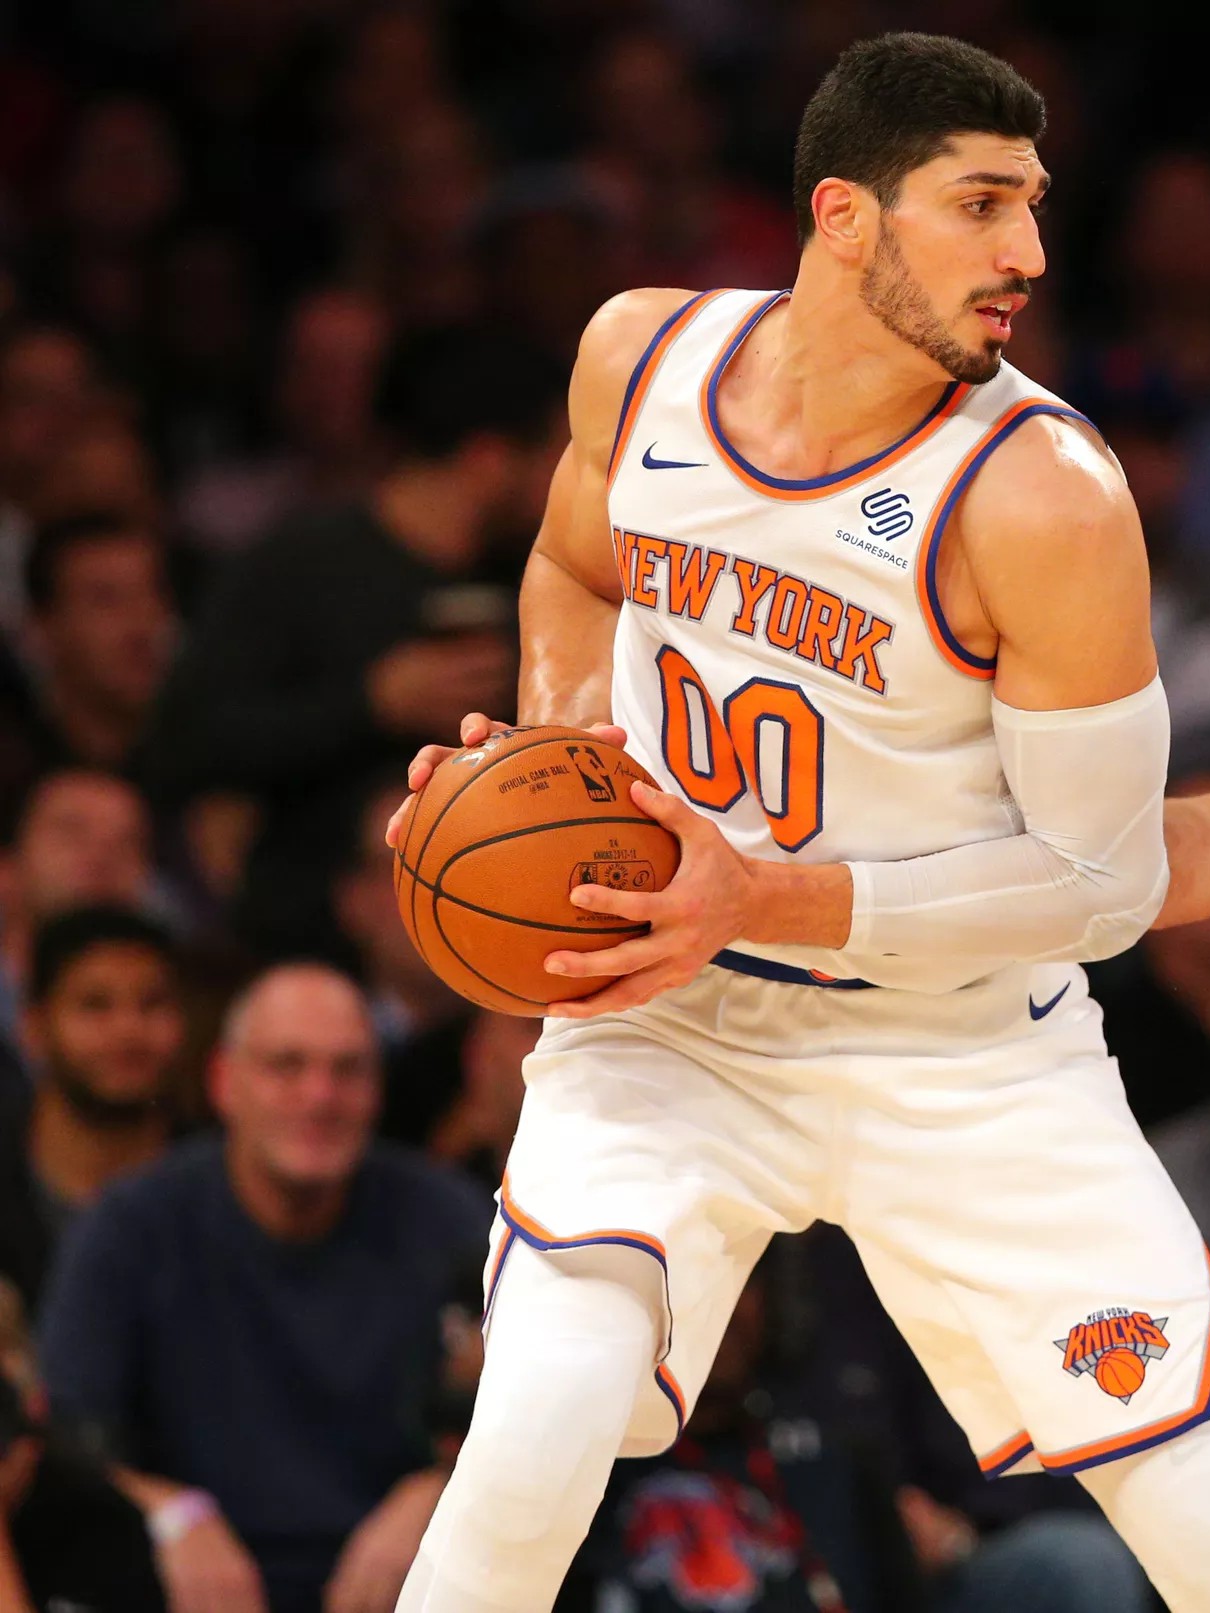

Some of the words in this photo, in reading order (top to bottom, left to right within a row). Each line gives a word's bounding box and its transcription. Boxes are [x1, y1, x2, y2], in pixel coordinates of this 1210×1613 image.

[835, 529, 908, 570] SQUARESPACE
[612, 524, 727, 624] NEW
[728, 552, 897, 700] YORK
[654, 643, 824, 854] 00
[498, 775, 529, 794] OFFICIAL
[529, 769, 550, 782] GAME
[550, 764, 570, 775] BALL
[589, 789, 610, 800] NBA
[1062, 1311, 1170, 1378] KNICKS
